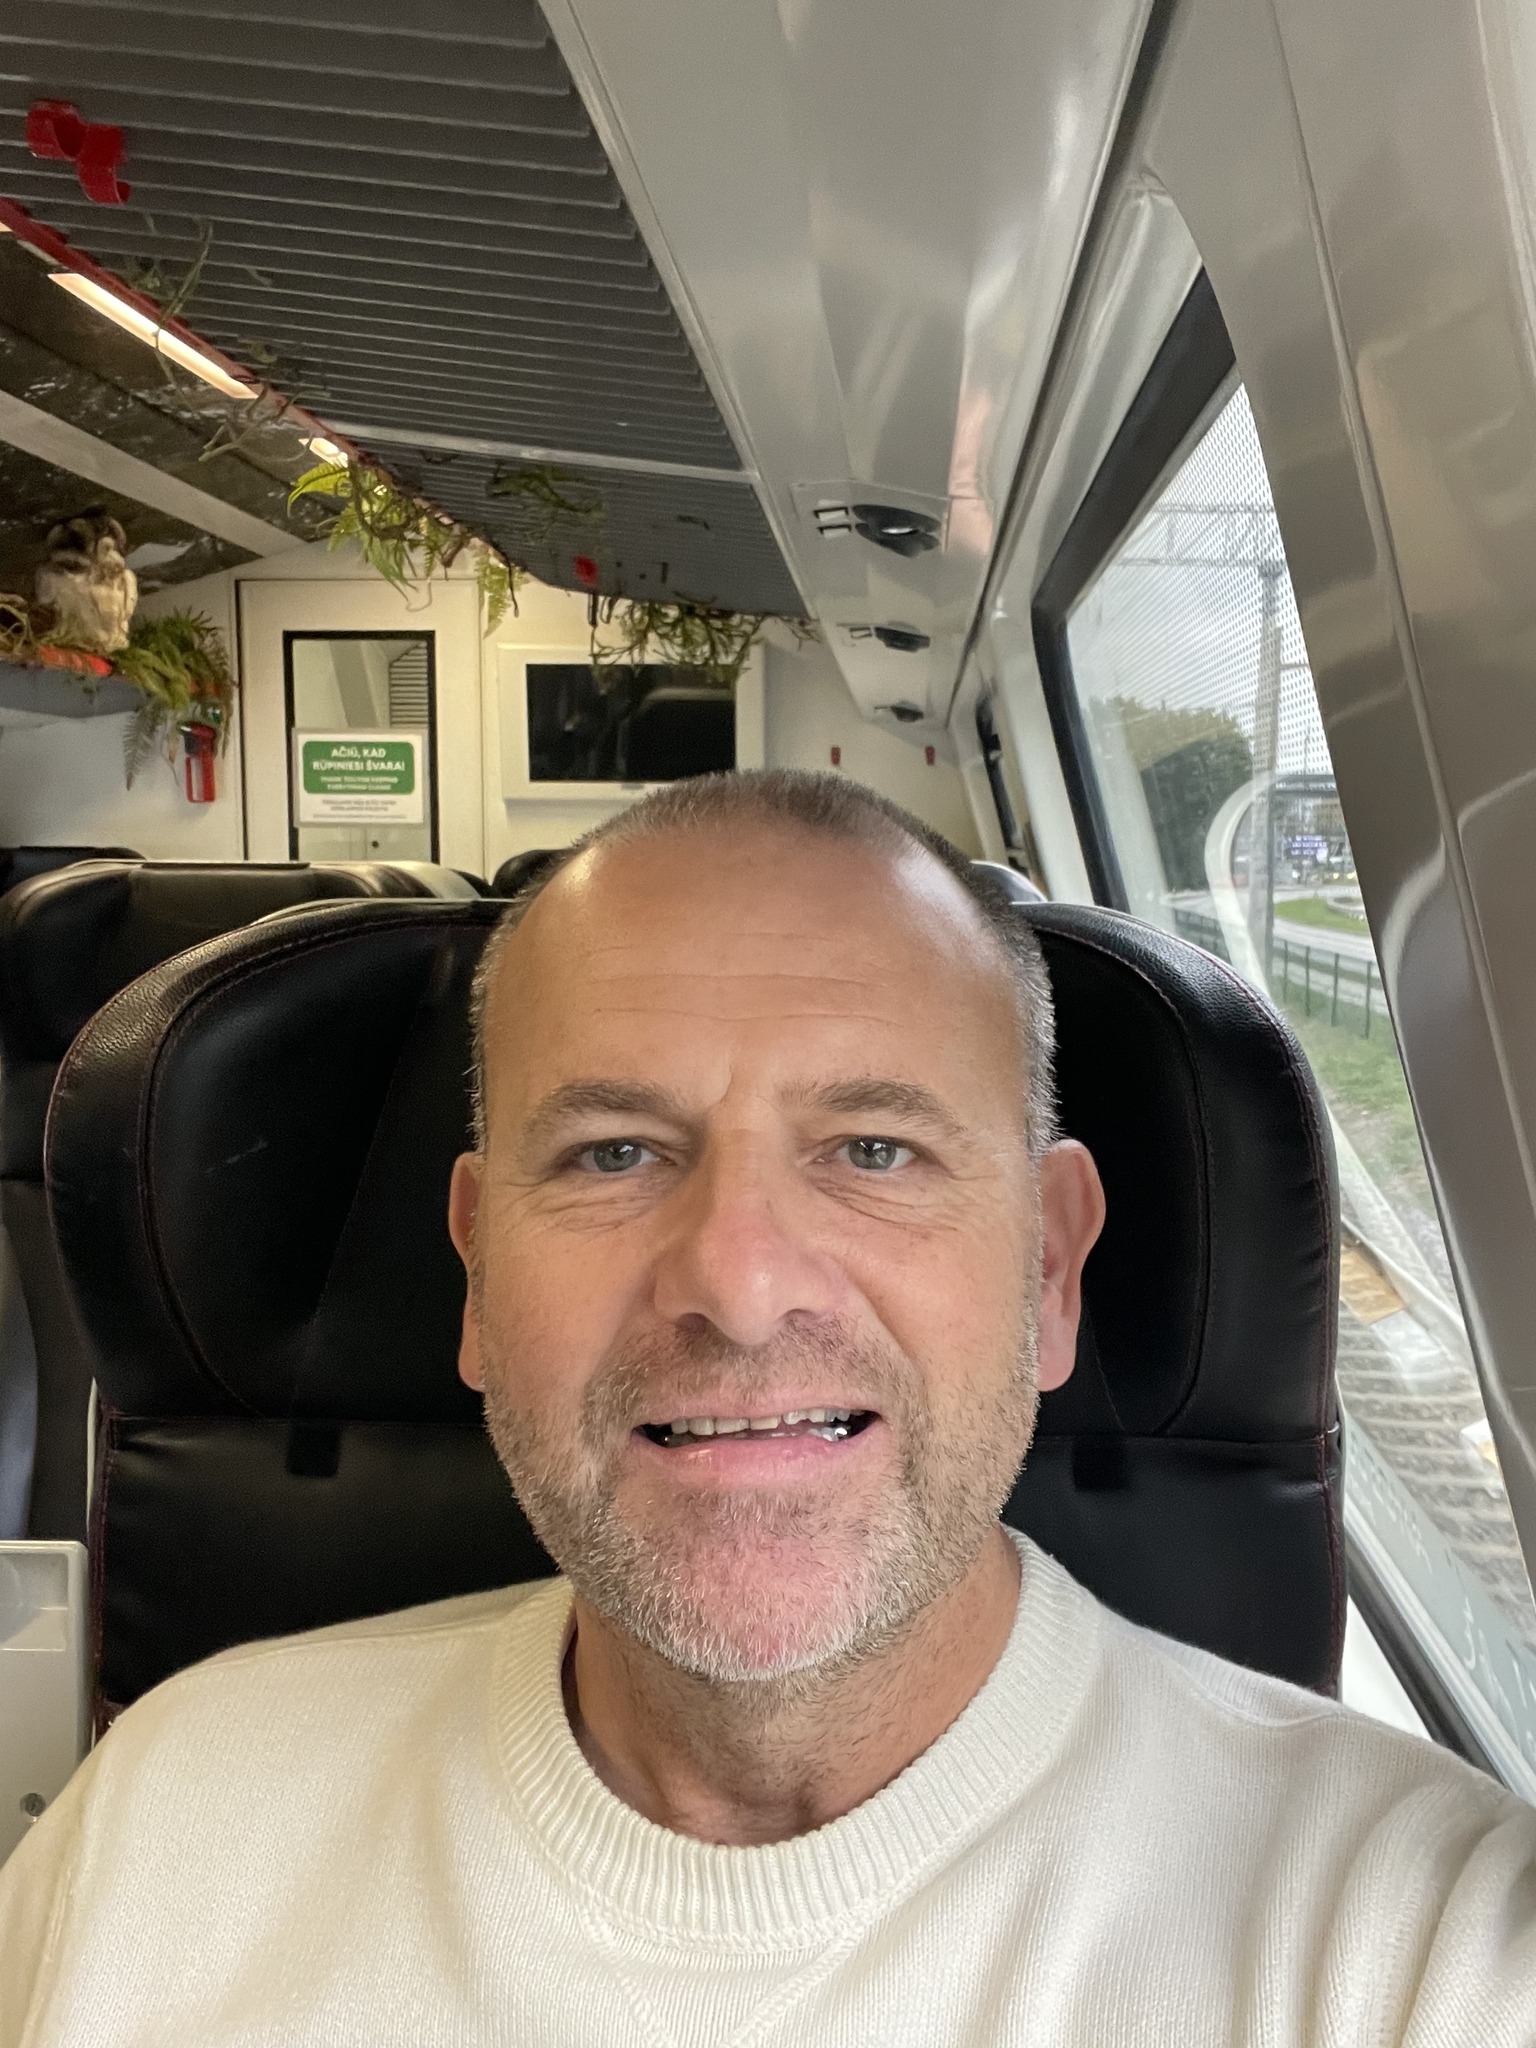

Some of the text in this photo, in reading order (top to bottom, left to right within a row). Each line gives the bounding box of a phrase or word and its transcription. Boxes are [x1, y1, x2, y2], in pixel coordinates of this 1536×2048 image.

[331, 746, 386, 758] AČIŪ, KAD
[366, 759, 405, 771] ŠVARA!
